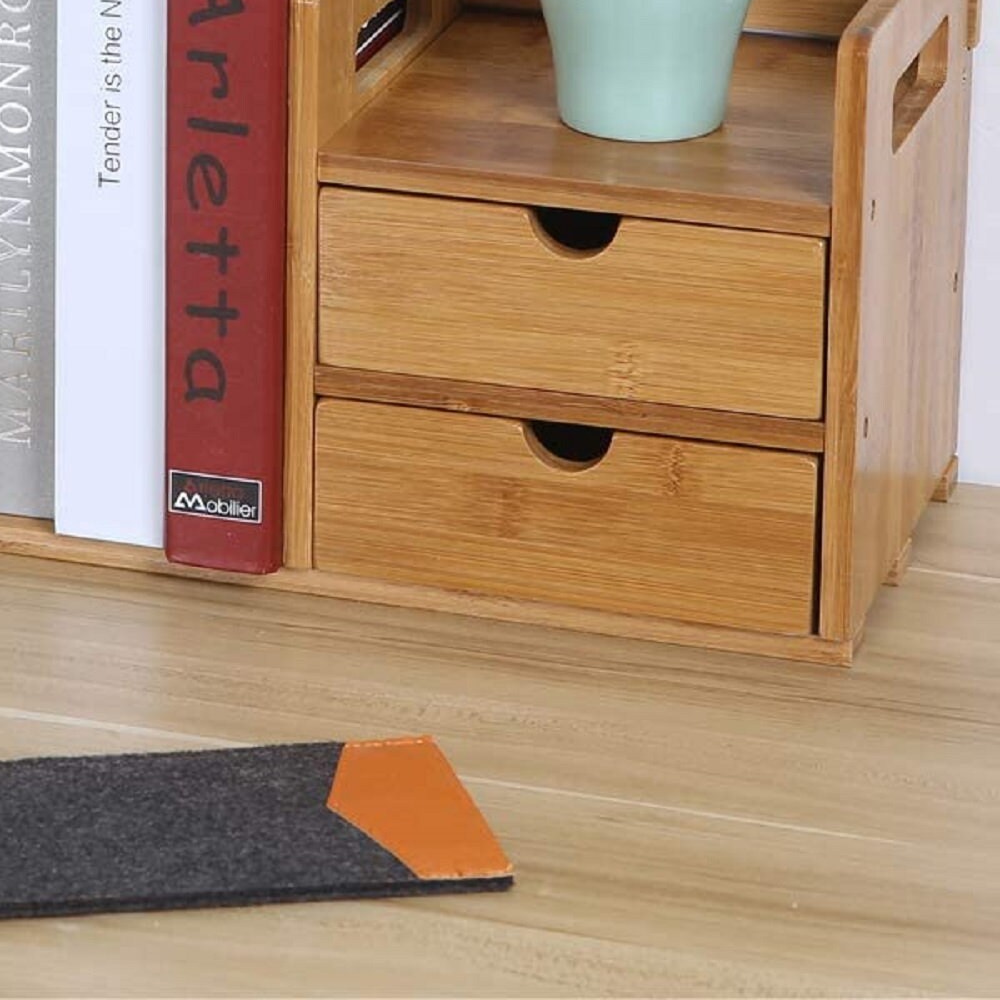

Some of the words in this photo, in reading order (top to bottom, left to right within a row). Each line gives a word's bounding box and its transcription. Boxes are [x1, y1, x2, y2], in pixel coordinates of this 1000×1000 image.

[100, 26, 122, 65] the
[100, 73, 122, 93] is
[97, 100, 122, 188] Tender
[173, 491, 257, 518] Mobilier
